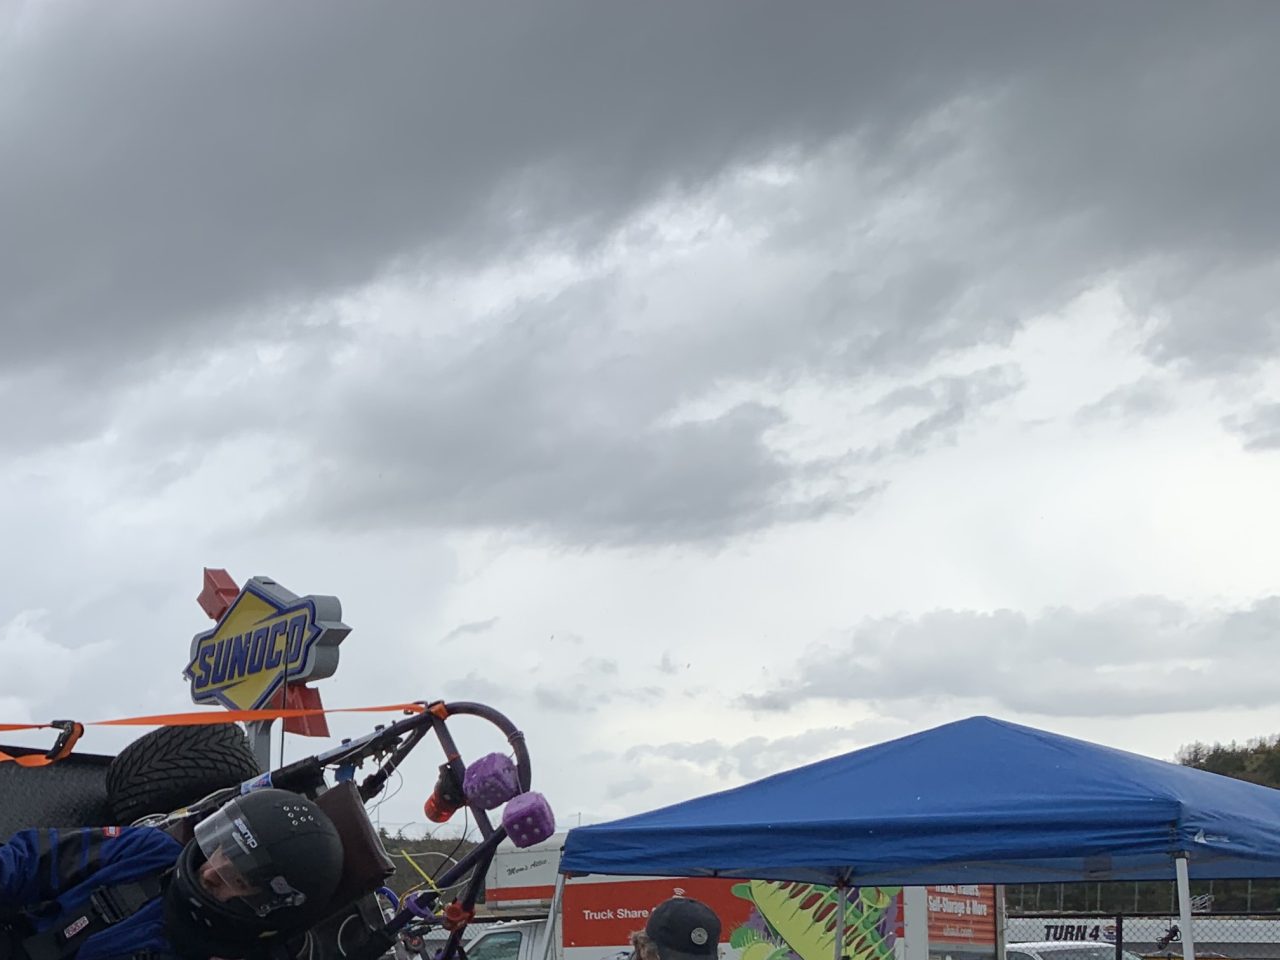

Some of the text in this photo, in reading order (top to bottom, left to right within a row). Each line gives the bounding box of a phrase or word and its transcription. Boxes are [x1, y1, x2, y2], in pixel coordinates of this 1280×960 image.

[195, 613, 308, 689] SUNOCO
[583, 909, 614, 920] Truck
[617, 908, 649, 919] Share
[1044, 925, 1100, 941] TURN 4
